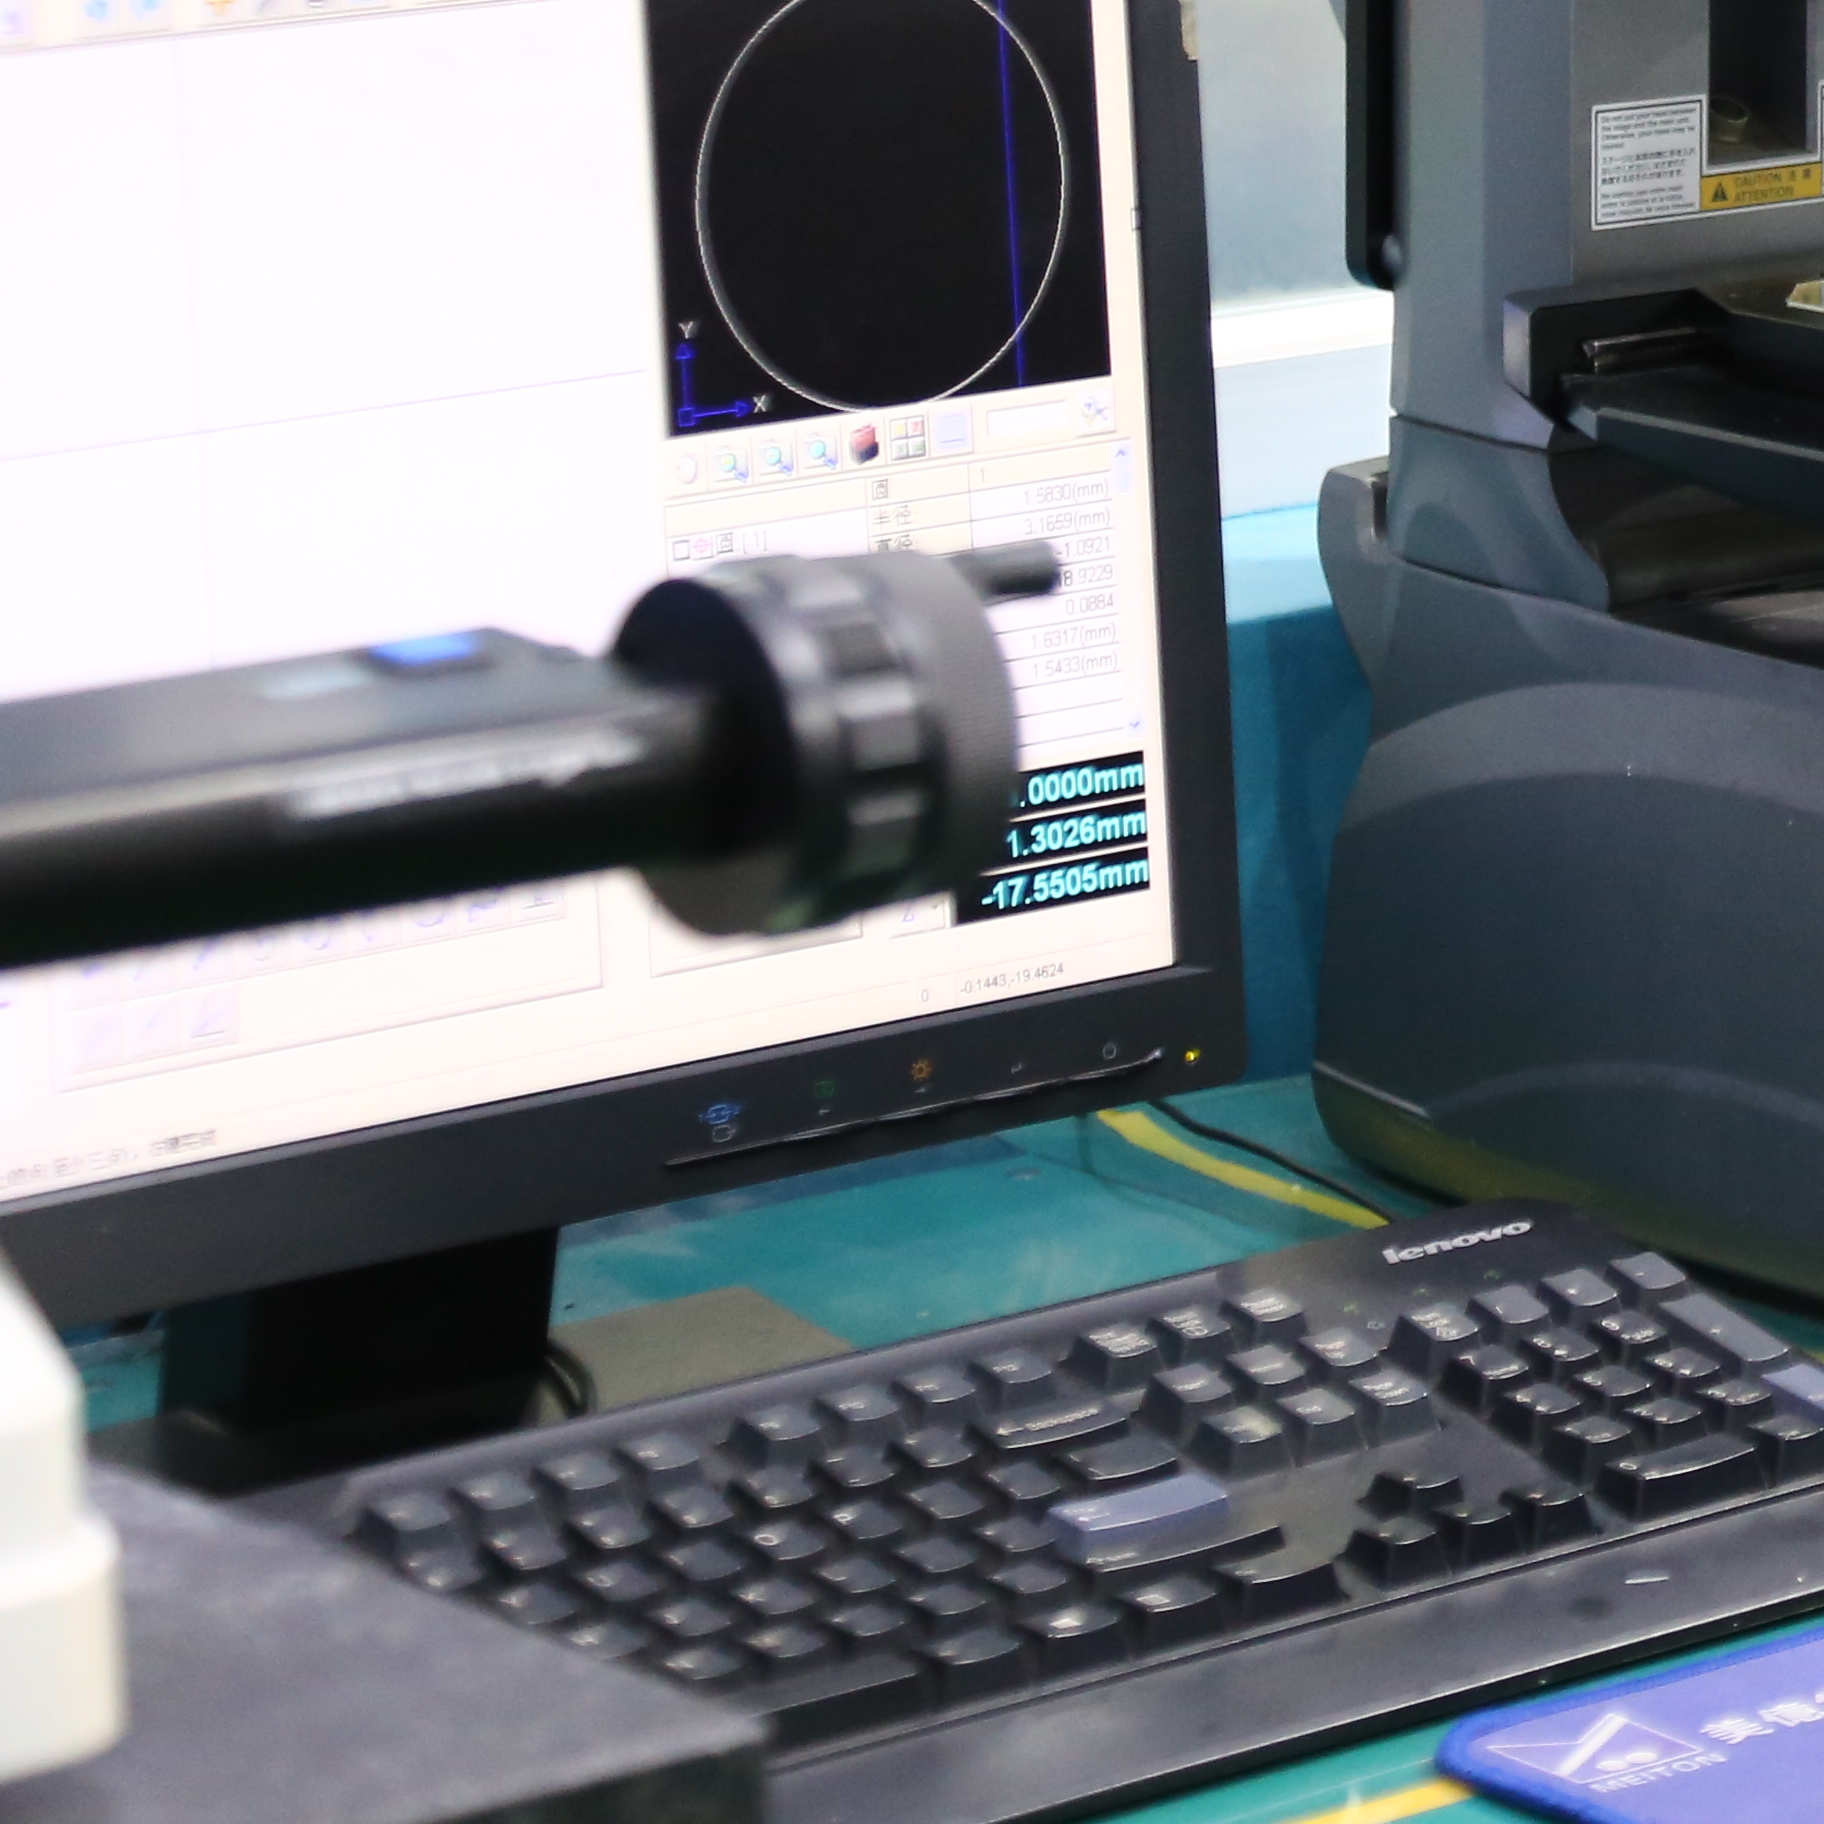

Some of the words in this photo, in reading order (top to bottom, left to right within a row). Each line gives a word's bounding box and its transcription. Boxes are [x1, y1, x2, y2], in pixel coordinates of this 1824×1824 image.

[678, 321, 698, 340] Y
[751, 394, 771, 413] X
[1006, 811, 1147, 858] 1.3026mm
[980, 859, 1149, 910] -17.5505mm
[1382, 1220, 1534, 1265] lenovo
[1590, 1750, 1728, 1794] MEITON
